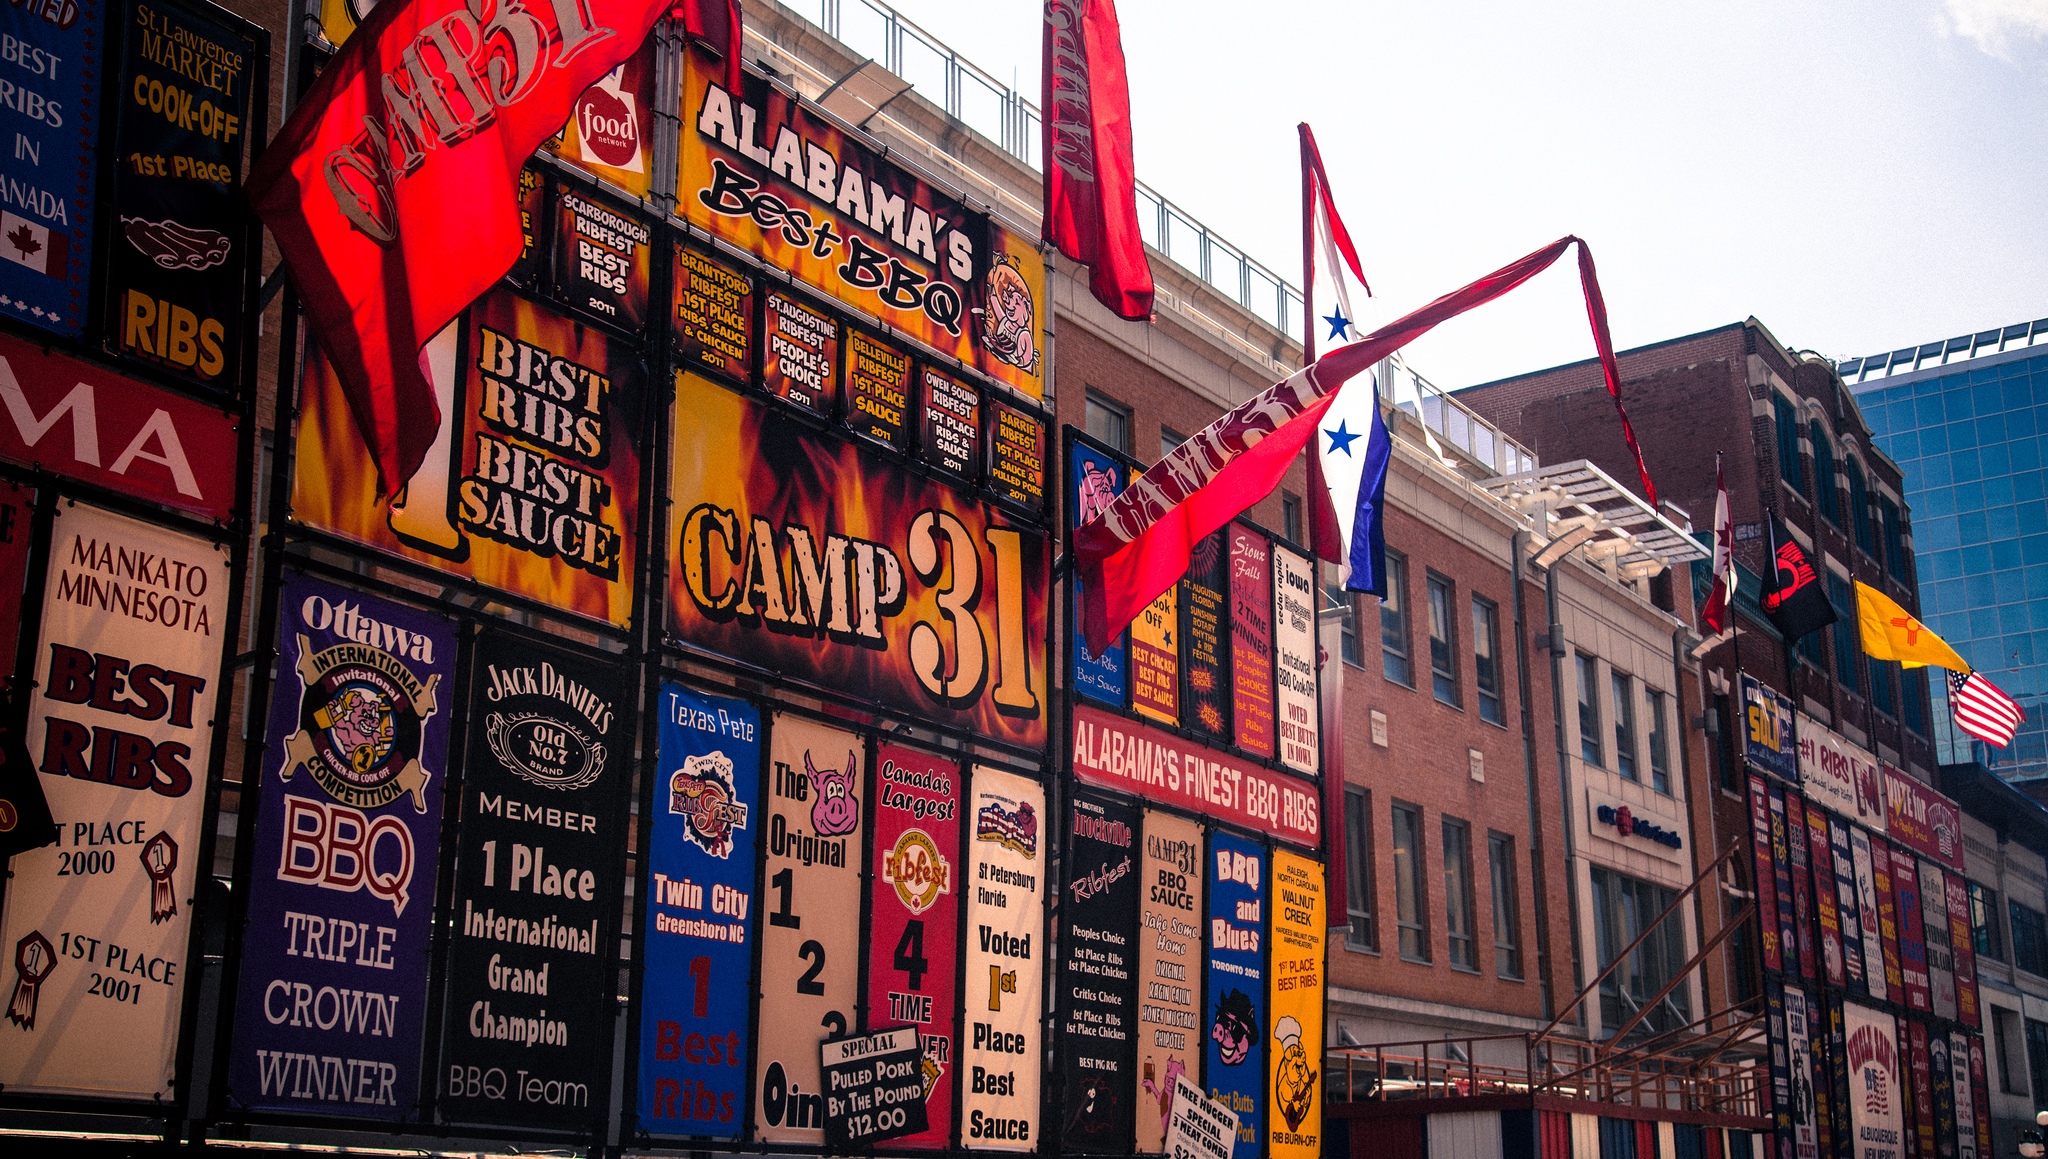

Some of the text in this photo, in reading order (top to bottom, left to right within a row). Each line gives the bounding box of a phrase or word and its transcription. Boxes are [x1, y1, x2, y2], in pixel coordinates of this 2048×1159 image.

[163, 16, 243, 70] Lawrence
[141, 29, 237, 97] MARKET
[134, 74, 238, 143] COOK-OFF
[583, 103, 635, 141] food
[15, 133, 40, 166] IN
[175, 155, 232, 184] Place
[699, 81, 973, 283] ALABAMA'S
[0, 178, 68, 226] ANADA
[563, 194, 648, 245] SCARBOROUGH
[575, 215, 634, 256] RIBFEST
[698, 158, 962, 337] Best BBQ
[578, 240, 630, 277] BEST
[681, 252, 750, 296] BRANTFORD
[580, 260, 628, 296] RIBS
[690, 274, 740, 310] RIBFEST
[684, 290, 745, 331] 1ST PLACE
[122, 288, 225, 380] RIBS
[697, 330, 743, 359] CHICKEN
[711, 322, 747, 347] SAUCE
[779, 316, 825, 350] RIBFEST
[480, 327, 610, 416] BEST
[701, 351, 725, 369] 2011
[772, 335, 830, 377] PEOPLE'S
[853, 337, 905, 373] BELLEVILLE
[858, 355, 901, 386] RIBFEST
[779, 358, 822, 391] CHOICE
[926, 372, 978, 406] OWEN SOUND
[789, 389, 810, 406] 2011
[855, 396, 901, 426] SAUCE
[874, 384, 905, 409] PLACE
[933, 390, 972, 419] RIBFEST
[481, 375, 602, 459] RIBS
[871, 426, 891, 441] 2011
[946, 416, 975, 439] PLACE
[1000, 410, 1036, 436] BARRIE
[936, 439, 969, 461] SAUCE
[999, 424, 1036, 452] RIBFEST
[476, 434, 604, 517] BEST
[1000, 460, 1027, 479] SAUCE
[1014, 449, 1041, 471] PLACE
[459, 480, 617, 571] SAUCE
[71, 534, 207, 597] MANKATO
[1231, 536, 1265, 562] Sioux
[683, 507, 902, 639] CAMP
[1235, 559, 1260, 580] Falls
[1286, 564, 1309, 594] iowa
[57, 569, 210, 636] MINNESOTA
[1193, 584, 1222, 603] AUGUSTINE
[302, 595, 435, 664] Ottawa
[1232, 617, 1268, 659] WINNER
[1245, 607, 1266, 635] TIME
[312, 646, 422, 704] INTERNATIONAL
[1133, 645, 1175, 675] BEST CHICKEN
[1139, 665, 1155, 683] BEST
[1237, 660, 1268, 679] Peoples
[1248, 652, 1269, 668] Place
[44, 642, 206, 730] BEST
[487, 661, 614, 735] JACK DANIEL'S
[1098, 675, 1121, 695] Sauce
[1136, 682, 1173, 708] BEST SAUCE
[1237, 676, 1268, 695] CHOICE
[669, 692, 754, 743] Texas Pete
[1250, 704, 1271, 720] Place
[1288, 702, 1308, 725] VOTED
[39, 715, 193, 799] RIBS
[1242, 733, 1268, 750] Sauce
[882, 760, 951, 796] Canada's
[1073, 720, 1317, 835] ALABAMA'S FINEST BBQ RIBS
[1800, 737, 1815, 766] #1
[1821, 745, 1849, 784] RIBS
[307, 756, 403, 806] COMPETITION
[775, 761, 808, 802] The
[1885, 773, 1913, 818] VOTE
[479, 791, 596, 834] MEMBER
[881, 784, 955, 820] Largest
[771, 814, 846, 868] Original
[1074, 809, 1131, 848] brockville
[57, 849, 115, 877] 2000
[277, 794, 415, 918] BBQ
[510, 843, 595, 901] Place
[1216, 849, 1260, 893] BBQ
[654, 873, 749, 920] Twin City
[1070, 855, 1131, 903] Ribfest
[1159, 869, 1186, 892] BBQ
[769, 868, 800, 930] 1
[1150, 885, 1193, 911] SAUCE
[1236, 898, 1260, 923] and
[1282, 888, 1315, 911] WALNUT
[463, 899, 598, 955] International
[656, 912, 727, 942] Greensboro
[1073, 925, 1125, 945] Peoples Choice
[1212, 917, 1260, 953] Blues
[1285, 907, 1312, 927] CREEK
[283, 911, 397, 971] TRIPLE
[894, 919, 927, 991] 4
[979, 924, 1031, 960] Voted
[1156, 934, 1186, 956] Home
[106, 943, 177, 987] PLACE
[488, 953, 549, 996] Grand
[1101, 965, 1127, 980] Chicken
[1155, 960, 1186, 982] ORIGINAL
[1212, 959, 1243, 975] TORONTO
[1290, 958, 1315, 974] PLACE
[87, 972, 141, 1005] 2001
[1073, 987, 1097, 1001] Critics
[1278, 977, 1298, 991] BEST
[264, 979, 399, 1038] CROWN
[469, 1000, 568, 1048] Champion
[655, 1020, 740, 1067] Best
[841, 1034, 897, 1059] SPECIAL
[973, 1022, 1025, 1055] Place
[1098, 1026, 1126, 1041] Chicken
[1154, 1029, 1185, 1050] CHIPOTLE
[1847, 1024, 1873, 1076] UNCLE
[256, 1049, 397, 1106] WINNER
[449, 1064, 588, 1108] BBQ Team
[763, 1061, 824, 1129] Oin
[972, 1066, 1015, 1097] Best
[652, 1077, 736, 1123] Ribs
[1178, 1082, 1234, 1131] TREE HUGGER
[1233, 1091, 1254, 1113] Butts
[848, 1107, 906, 1140] $12.00
[970, 1110, 1029, 1141] Sauce
[1187, 1108, 1221, 1141] SPECIAL
[1860, 1126, 1898, 1145] ALBUQUERQUE
